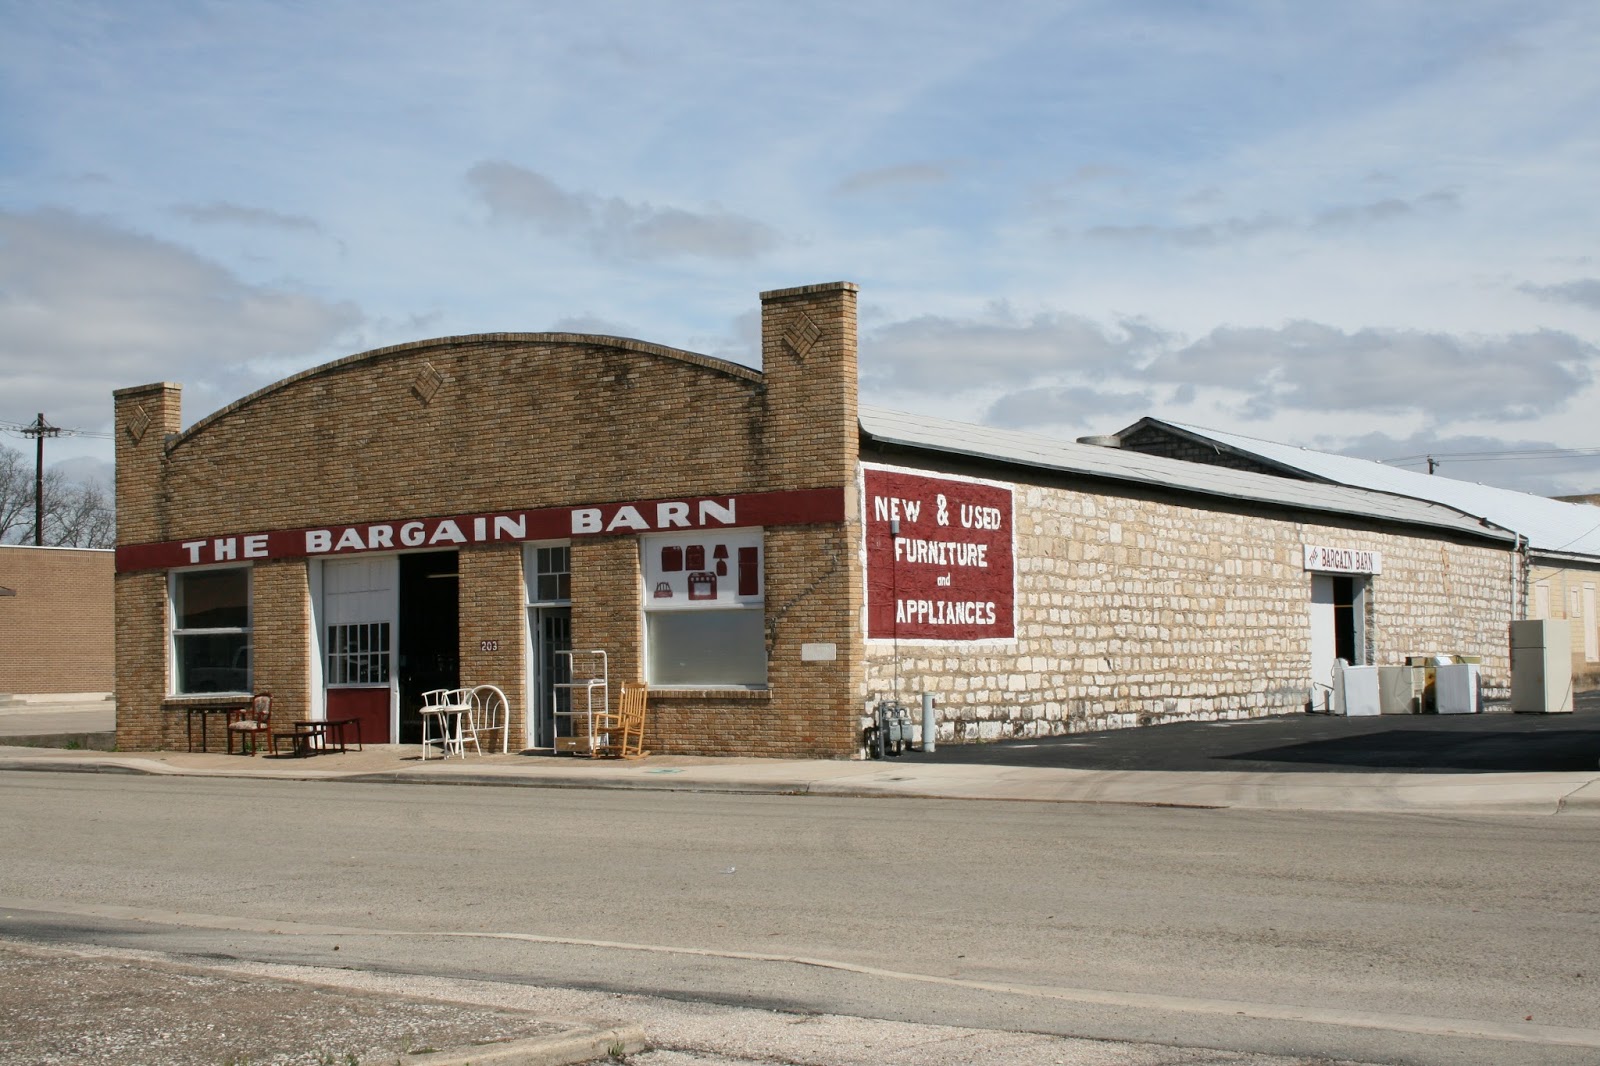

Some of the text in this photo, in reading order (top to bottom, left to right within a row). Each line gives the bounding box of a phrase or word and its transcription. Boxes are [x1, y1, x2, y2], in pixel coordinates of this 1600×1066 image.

[874, 494, 1001, 530] NEW & USED
[182, 498, 736, 563] THE BARGAIN BARN
[895, 537, 988, 567] FURNITURE
[1321, 548, 1352, 570] BARGAIN
[1355, 551, 1373, 571] BARN
[937, 572, 951, 587] and
[896, 599, 996, 625] APPLIANCES
[481, 641, 497, 651] 203
